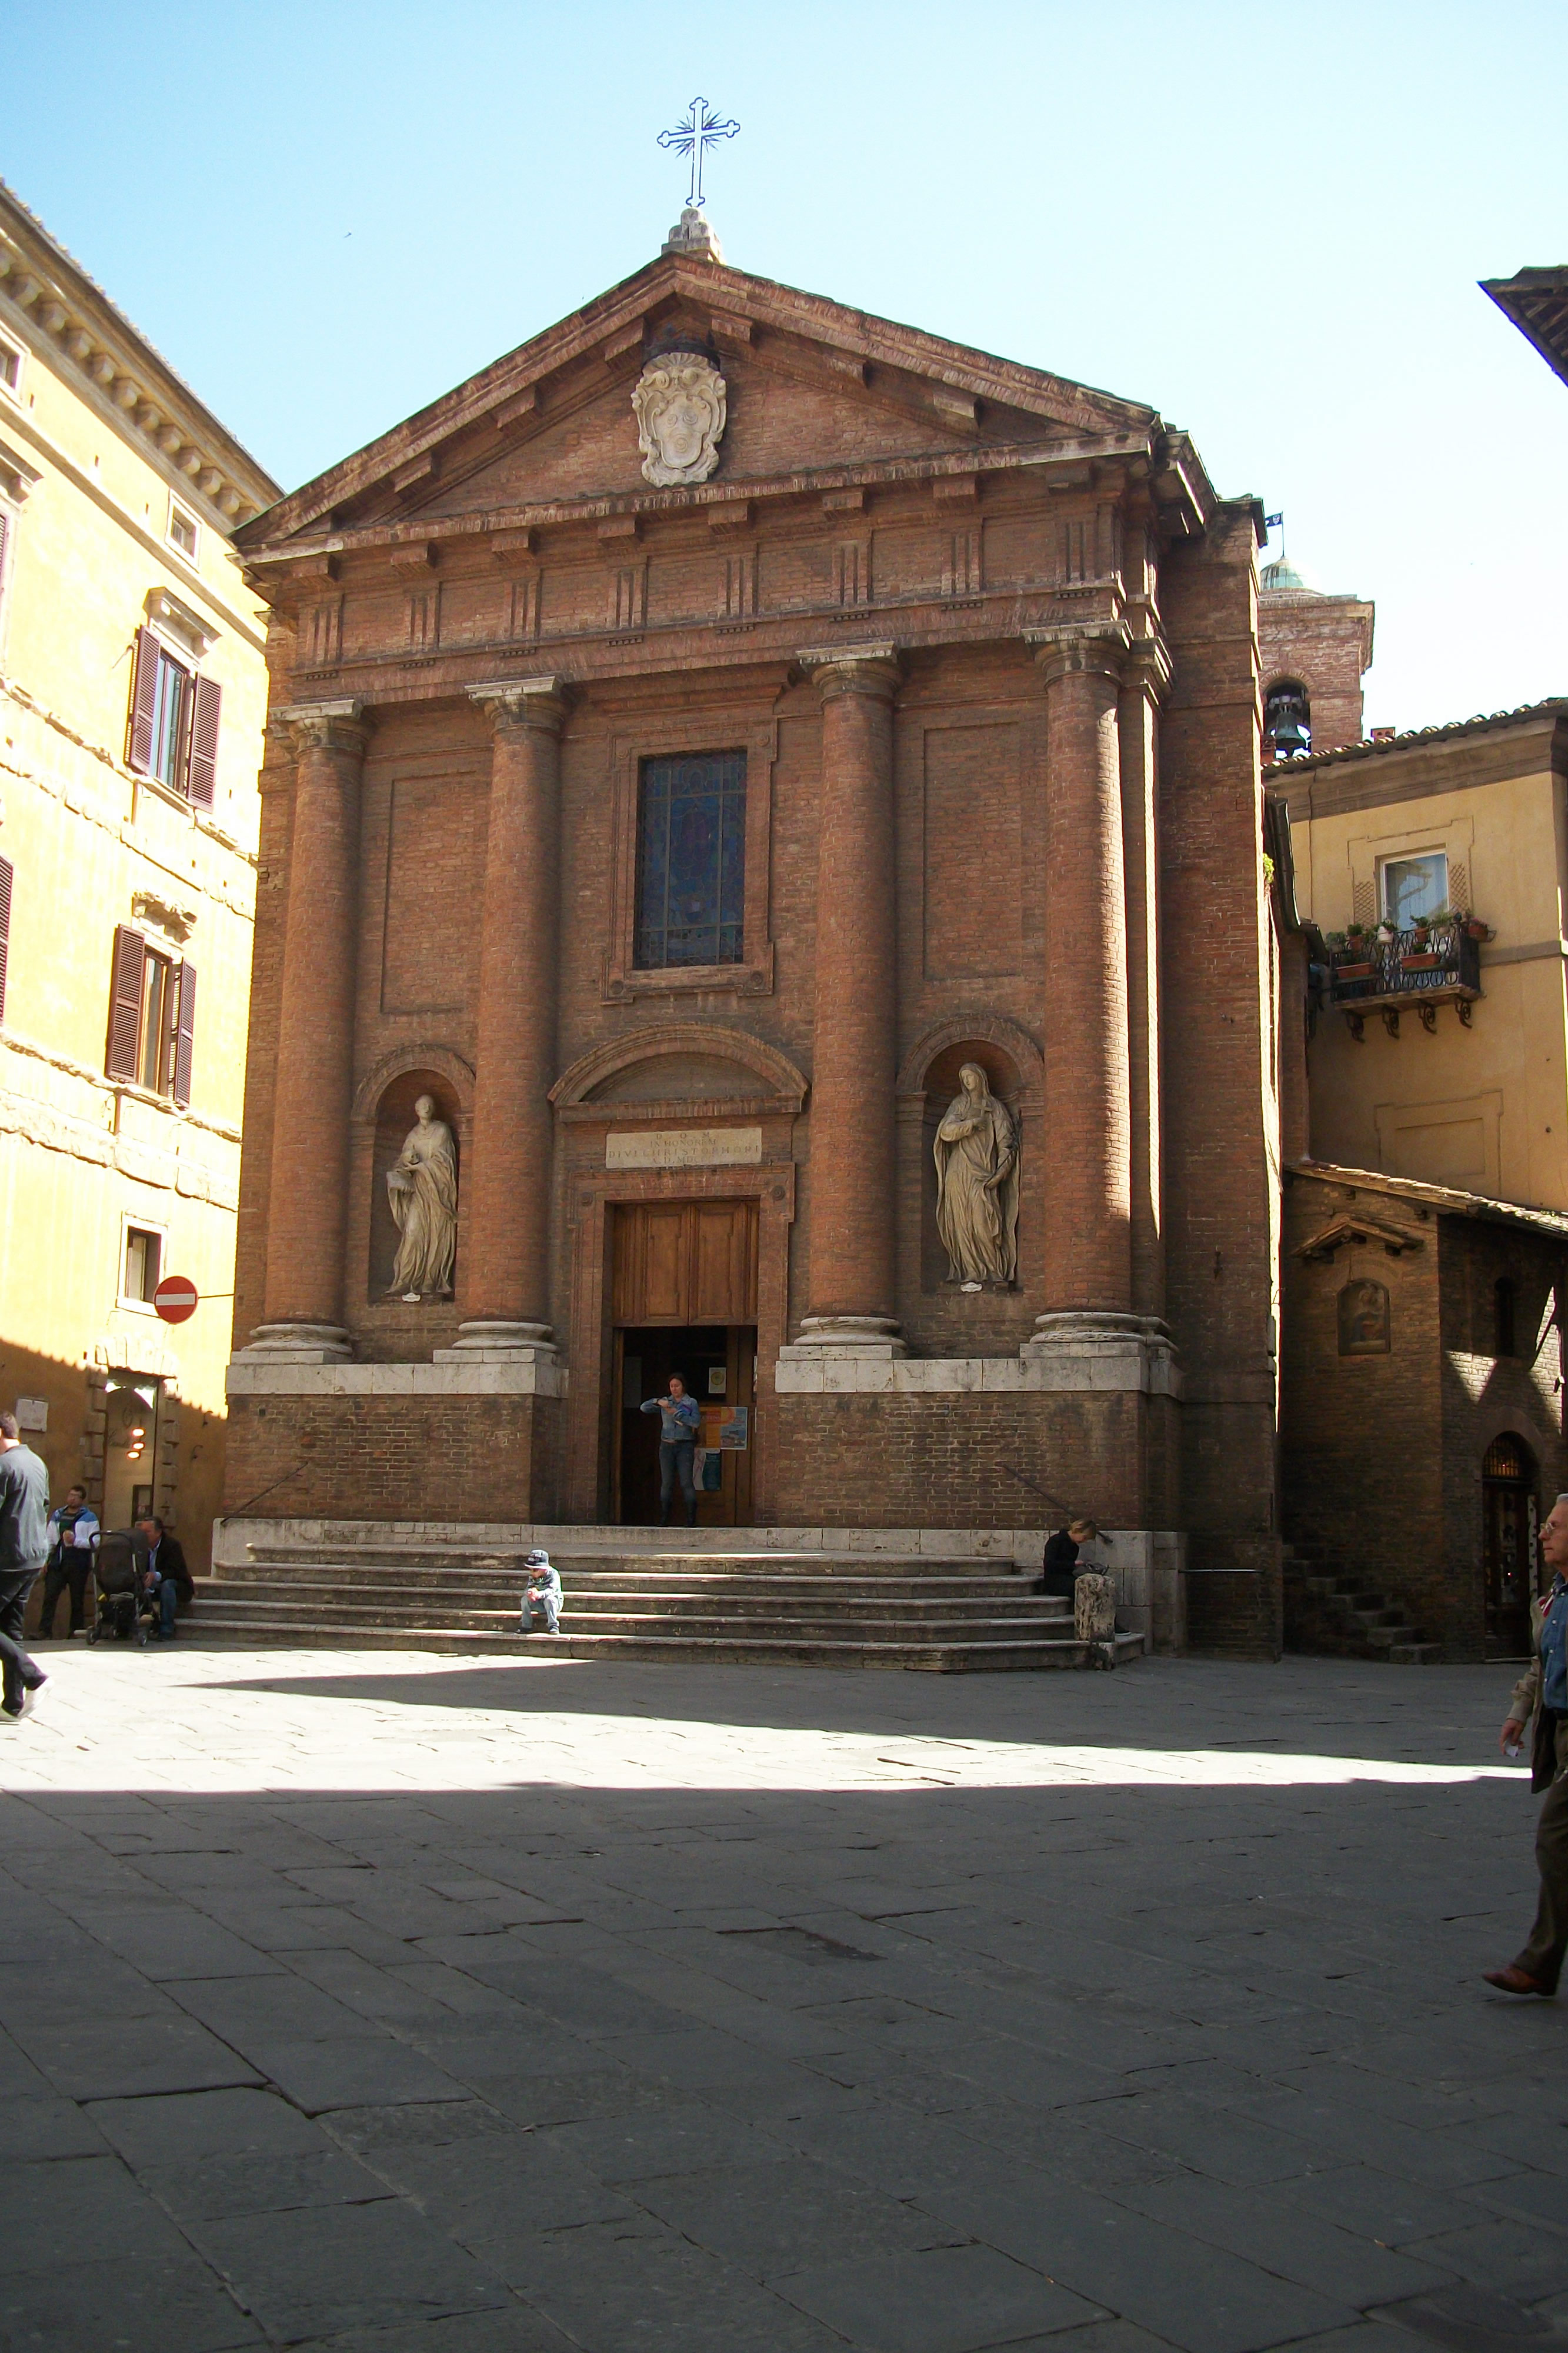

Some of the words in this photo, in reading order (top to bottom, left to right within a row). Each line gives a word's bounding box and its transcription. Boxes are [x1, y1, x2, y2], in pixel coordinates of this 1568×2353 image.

[664, 1138, 716, 1146] HONOREM
[609, 1149, 637, 1158] DIVI
[643, 1145, 759, 1157] CHRISTOPHORI
